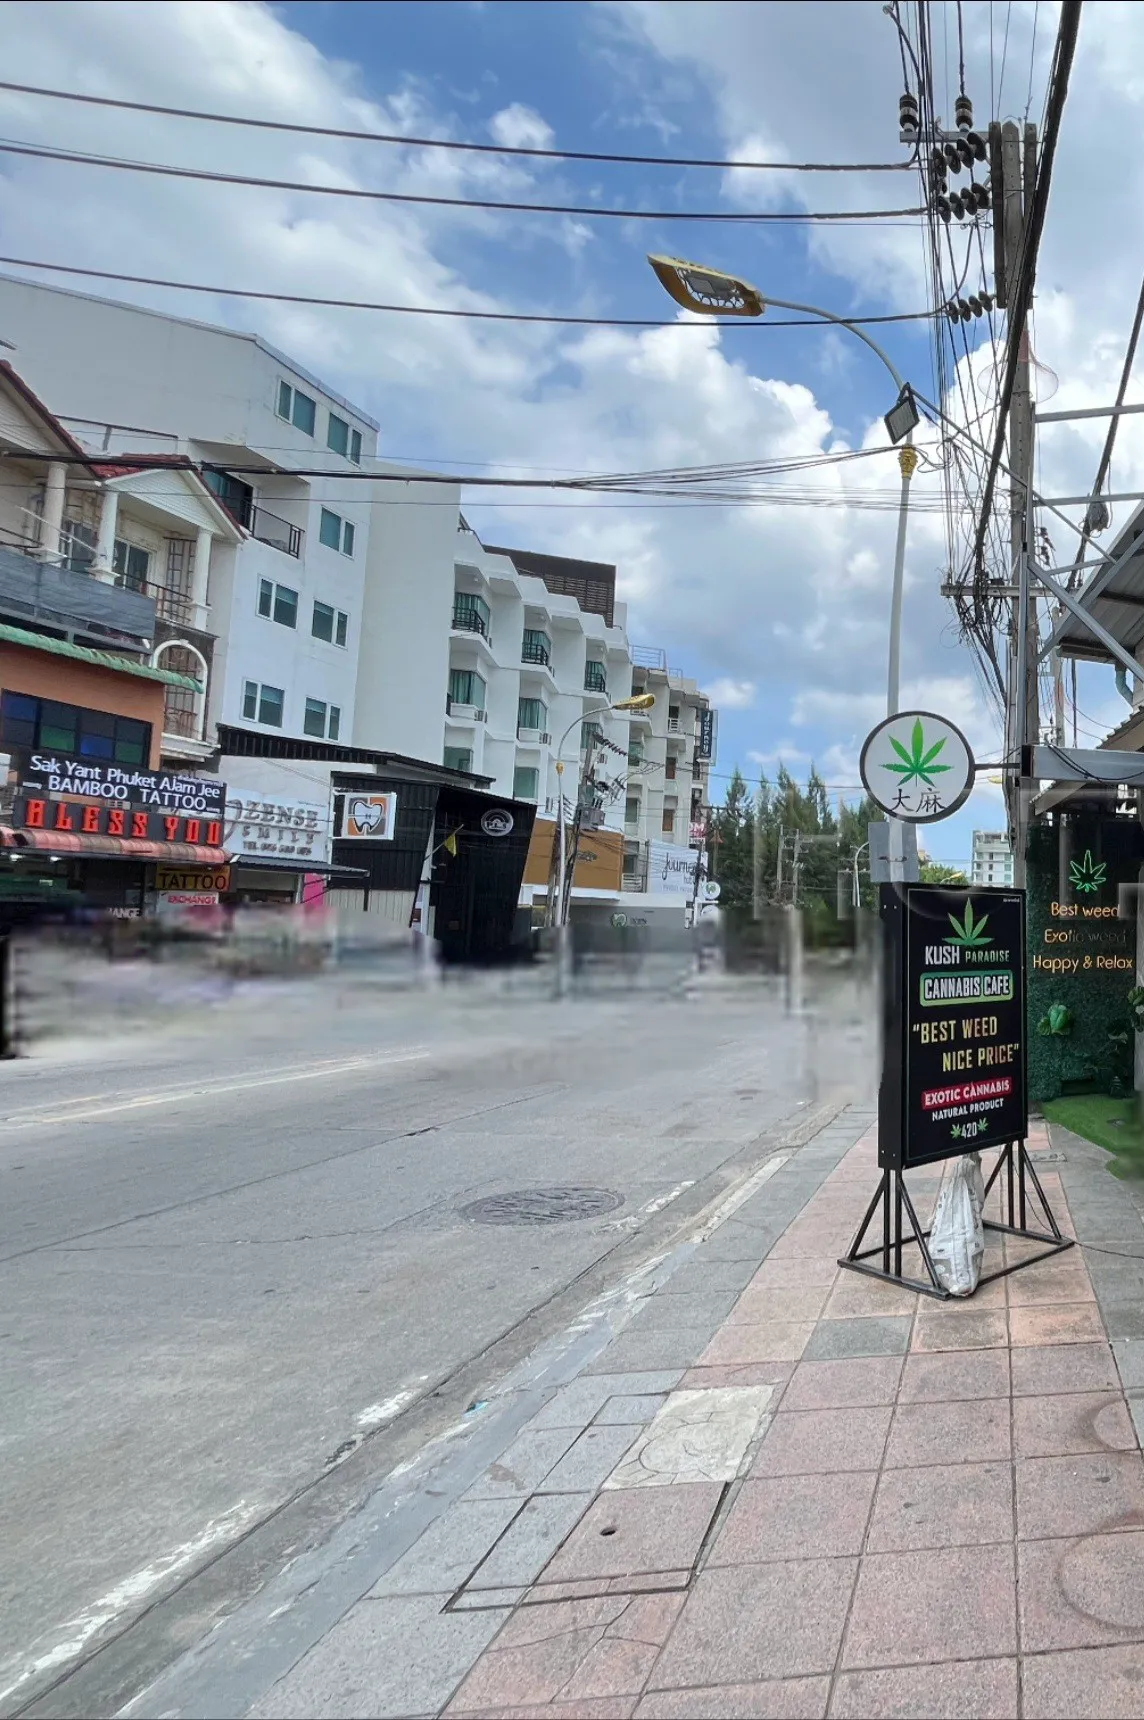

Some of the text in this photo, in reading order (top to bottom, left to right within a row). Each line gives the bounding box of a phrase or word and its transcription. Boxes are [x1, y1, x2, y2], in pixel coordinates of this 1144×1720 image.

[30, 755, 60, 774] Sak
[65, 760, 101, 780] Yant
[107, 768, 156, 788] Phuket
[198, 784, 220, 798] Jee
[49, 775, 207, 811] BAMBOO TATTOO
[889, 787, 947, 814] 大麻
[25, 799, 221, 845] BLESS YOU
[159, 873, 226, 890] TATTOO
[1050, 902, 1120, 918] Best weed
[1044, 928, 1084, 944] Exotic
[925, 945, 1010, 965] KUSH PARADISE
[1032, 954, 1133, 974] Happy & Relax
[924, 975, 1009, 1000] CANNABIS CAFE
[962, 1016, 998, 1039] WEED
[942, 1050, 973, 1072] NICE
[924, 1079, 1010, 1106] EXOTIC CANNABIS
[932, 1098, 1004, 1121] NATURAL PRODUCT
[961, 1122, 977, 1138] 420
